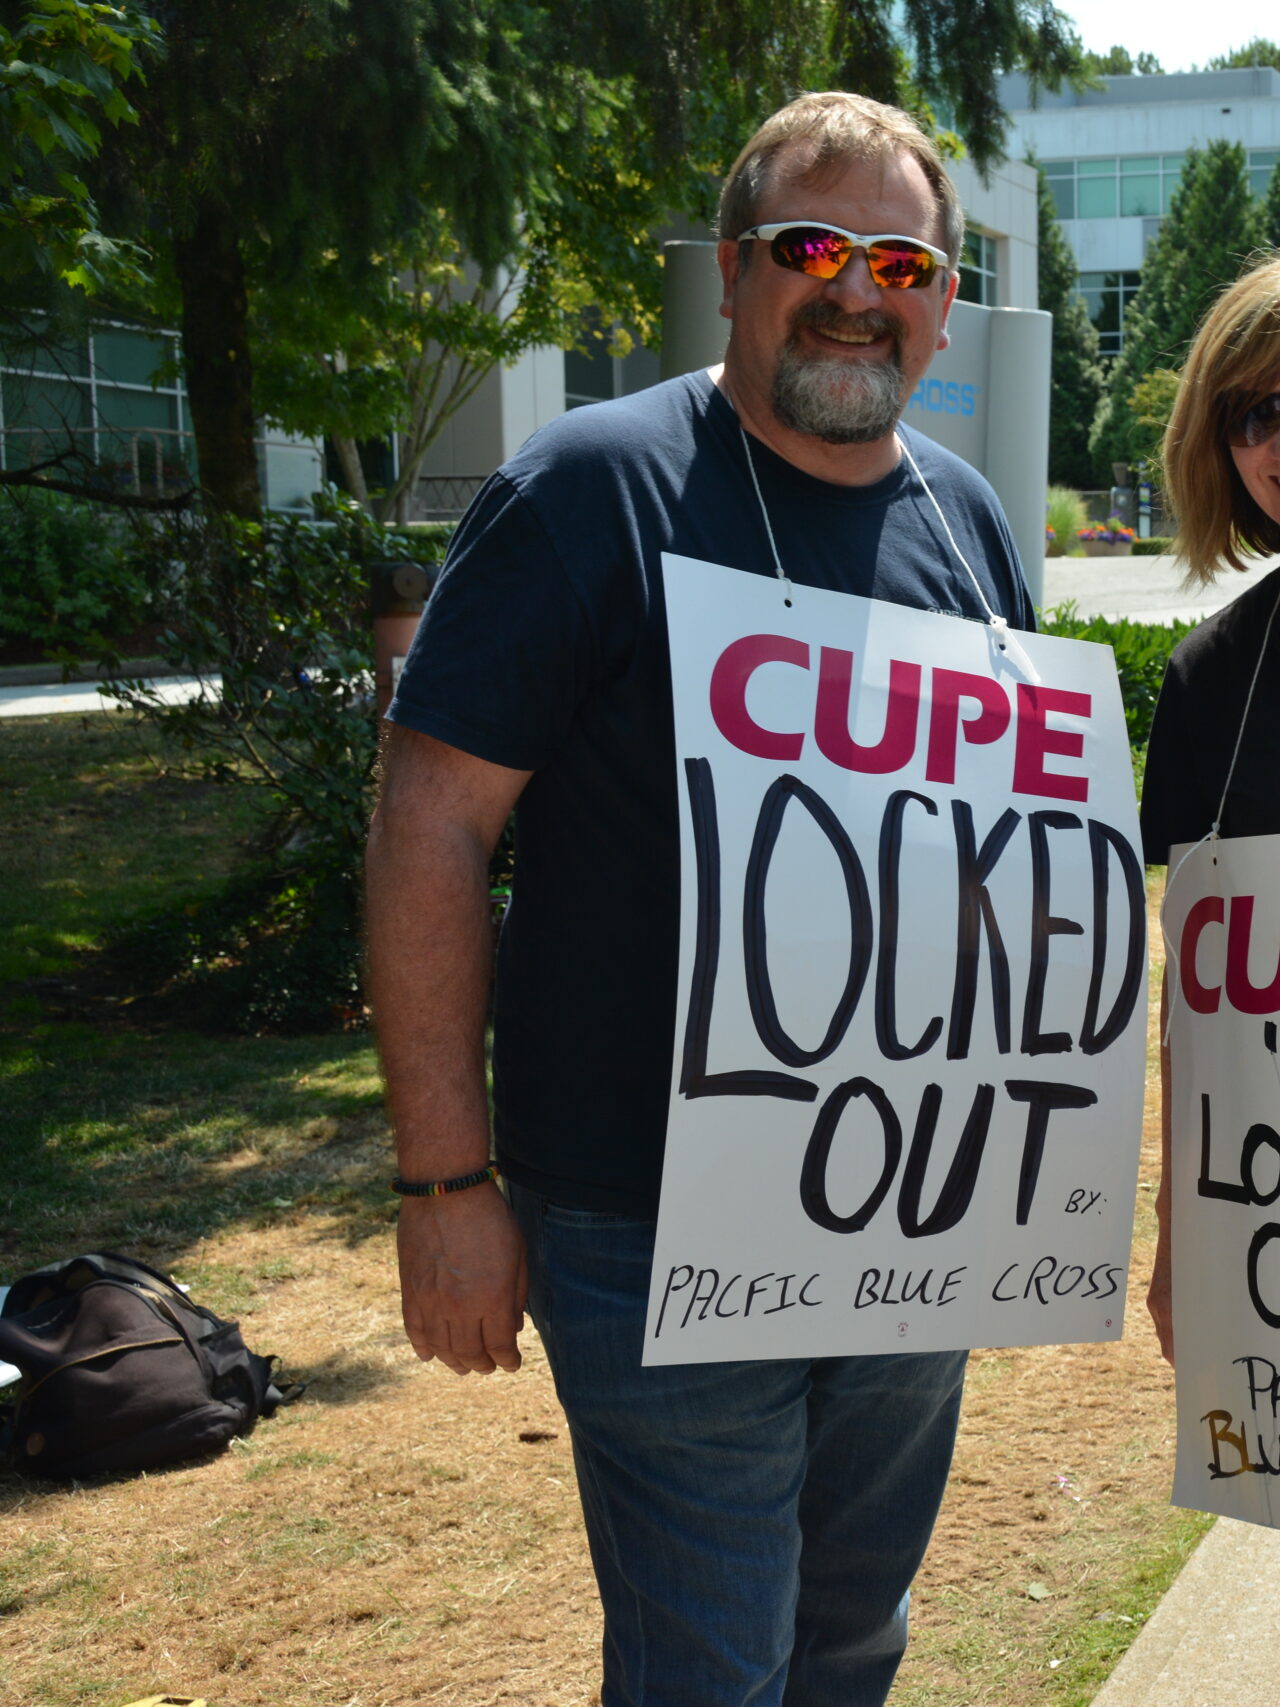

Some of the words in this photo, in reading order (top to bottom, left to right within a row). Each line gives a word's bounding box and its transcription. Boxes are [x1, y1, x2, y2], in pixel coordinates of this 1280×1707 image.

[908, 378, 976, 417] ROSS
[710, 634, 1092, 802] CUPE
[678, 757, 1146, 1101] LOCKED
[800, 1076, 1098, 1238] OUT
[1065, 1187, 1108, 1217] BY:
[655, 1264, 823, 1338] PACFIC
[854, 1264, 969, 1310] BLUE
[992, 1254, 1124, 1303] CROSS
